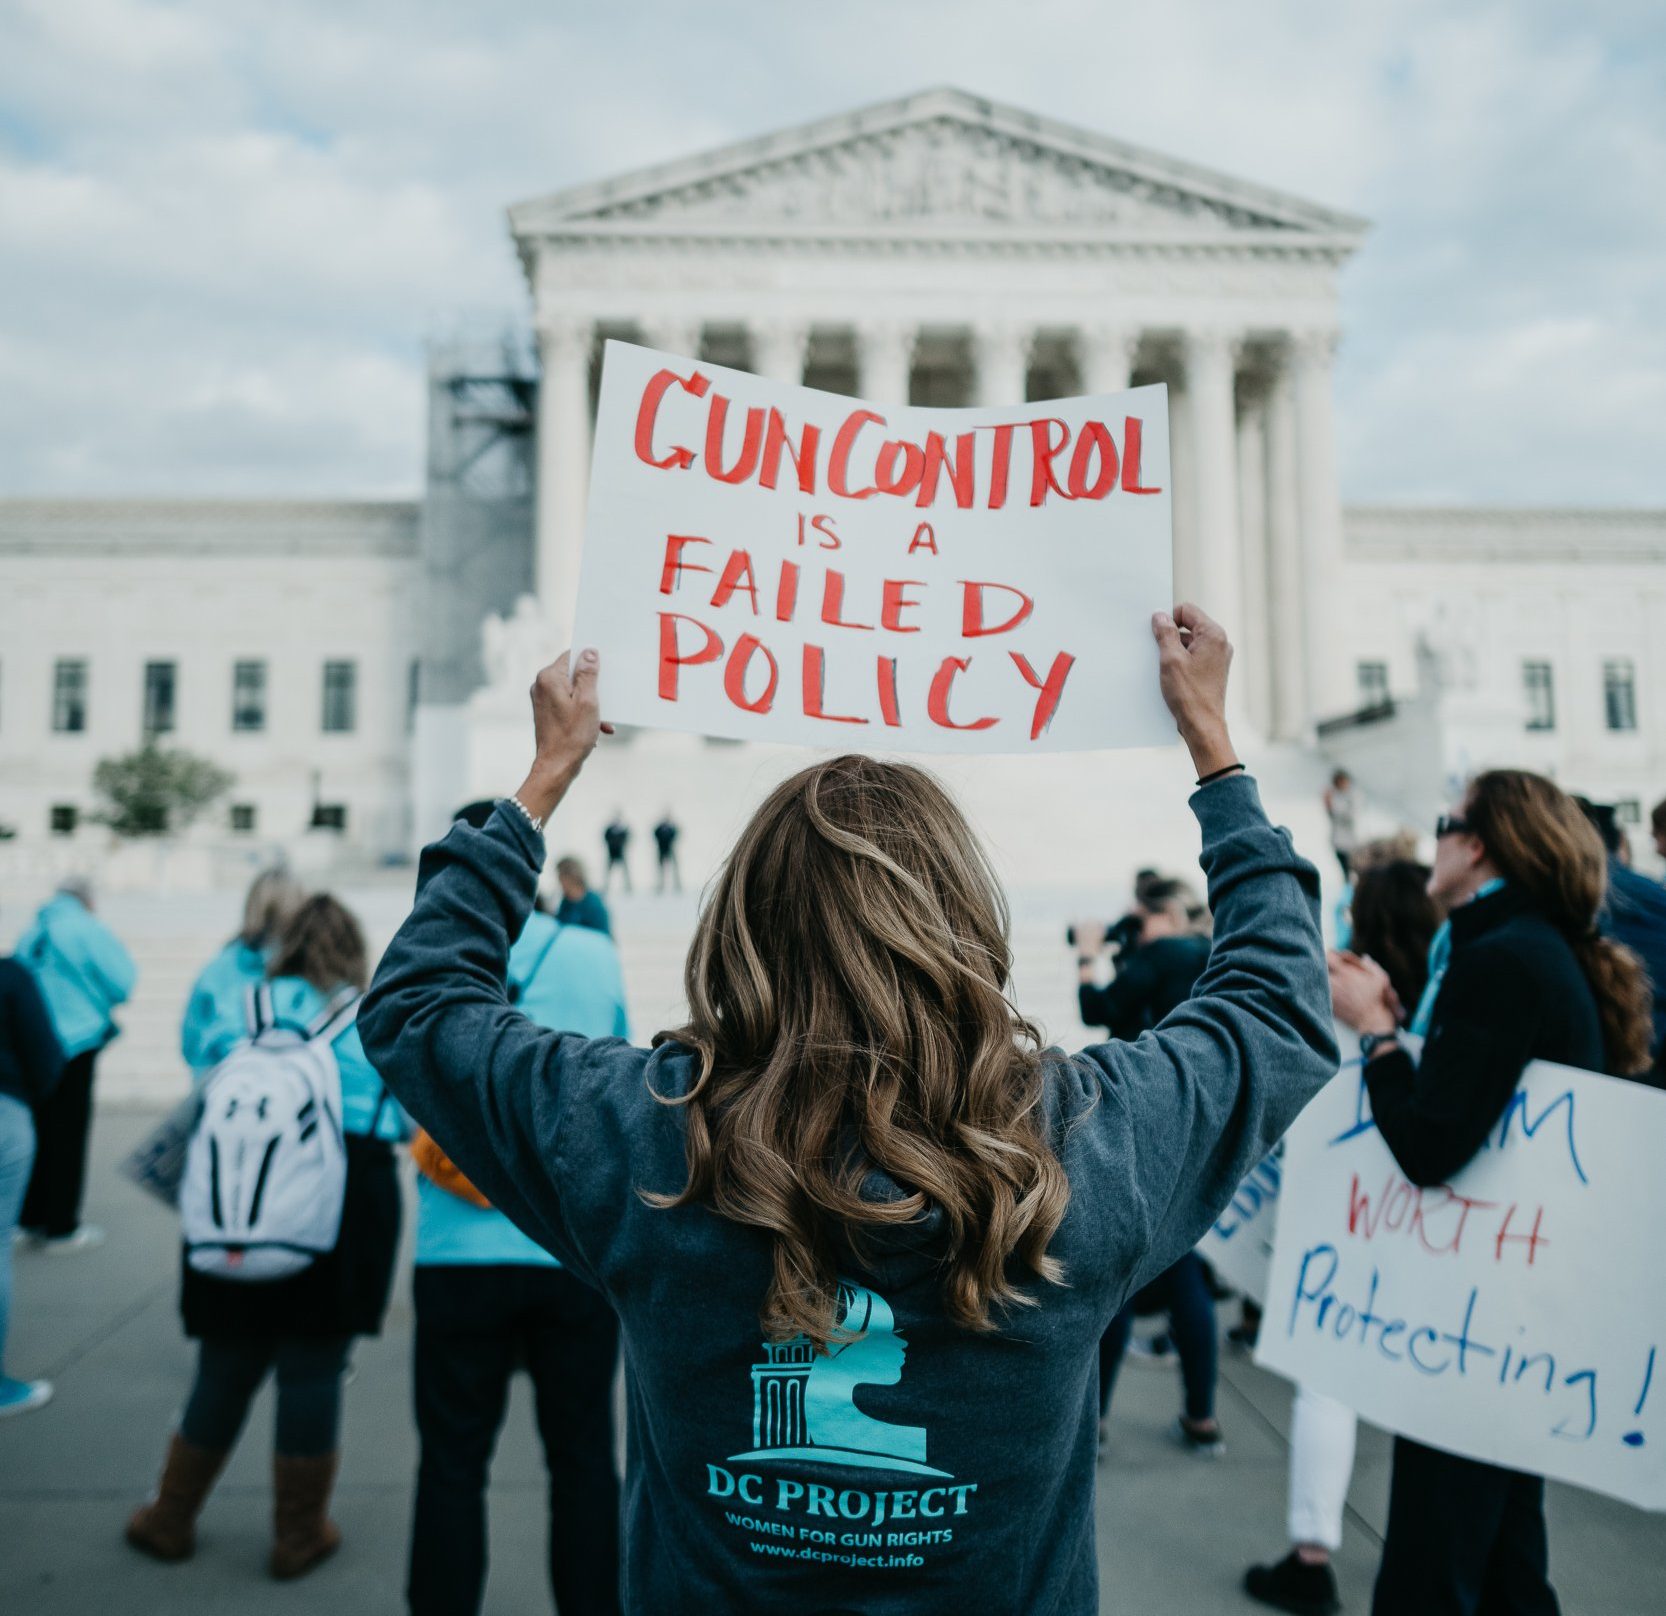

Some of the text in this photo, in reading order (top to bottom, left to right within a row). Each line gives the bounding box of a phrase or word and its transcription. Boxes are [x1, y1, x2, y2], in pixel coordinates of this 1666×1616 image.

[798, 513, 939, 555] IS A
[659, 534, 1034, 638] FAILED
[657, 612, 1075, 741] POLICY
[1348, 1173, 1550, 1265] WORTH
[706, 1463, 978, 1527] DC PROJECT
[725, 1511, 953, 1548] WOMEN FOR GUN RIGHTS
[750, 1542, 925, 1568] www.dcproject.info
